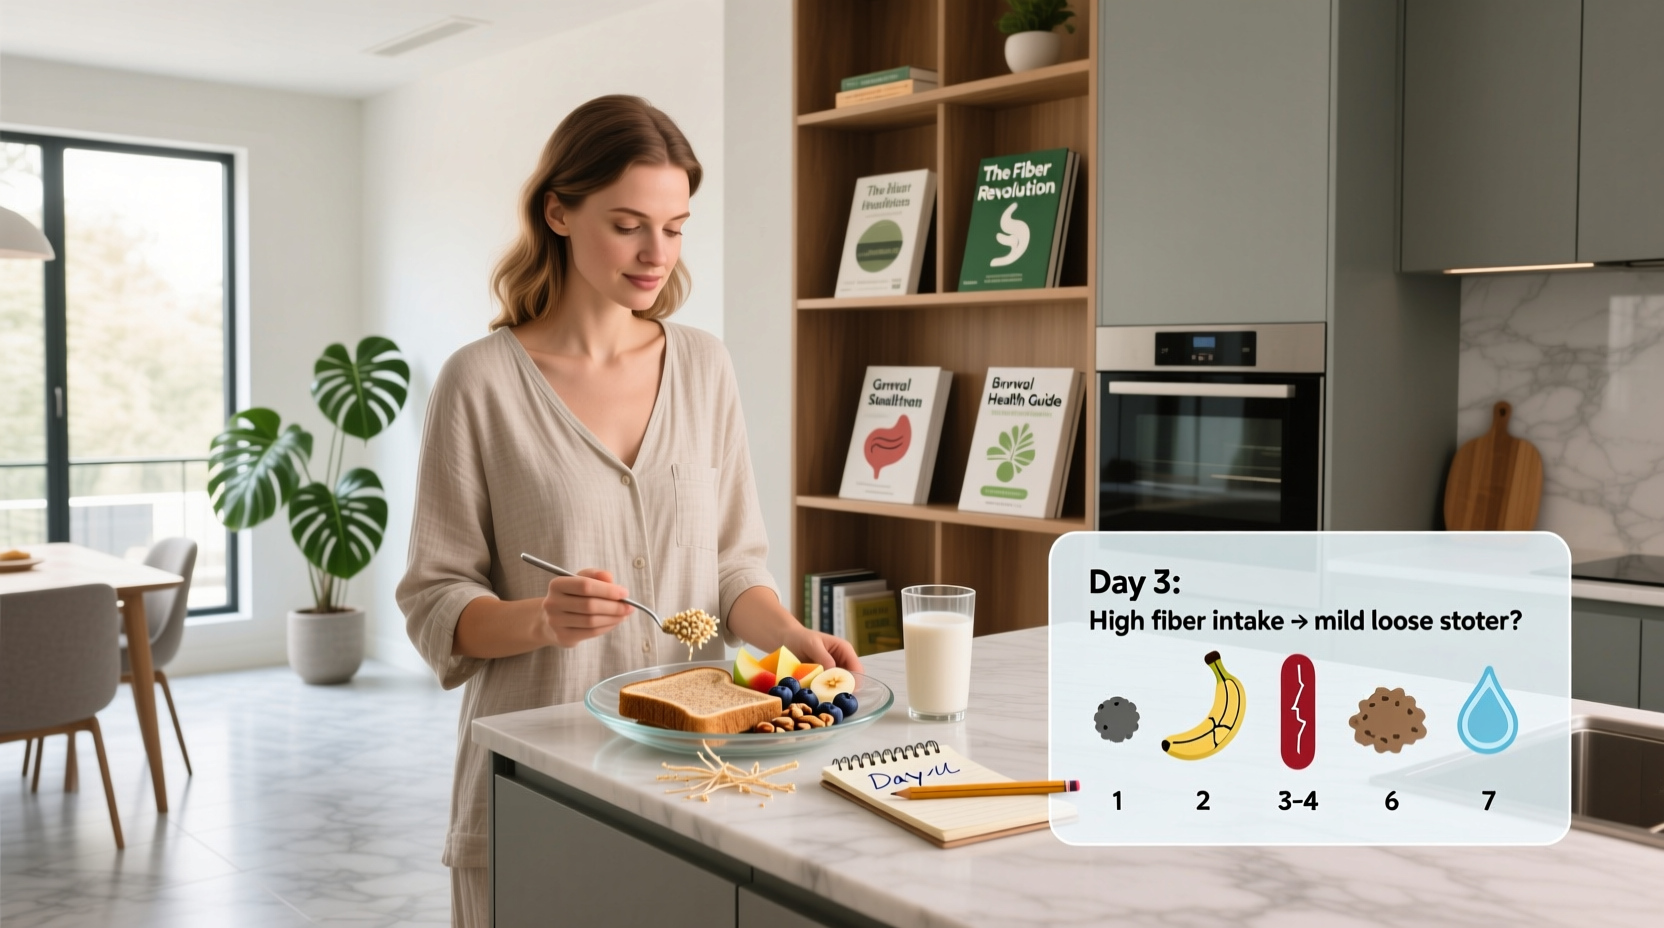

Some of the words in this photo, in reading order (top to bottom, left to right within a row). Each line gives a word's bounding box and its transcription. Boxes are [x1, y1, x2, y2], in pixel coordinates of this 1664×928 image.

[983, 164, 1011, 182] The
[1013, 160, 1052, 179] Fiber
[977, 179, 1056, 201] Revolution
[987, 392, 1026, 407] Health
[1028, 392, 1062, 408] Guide
